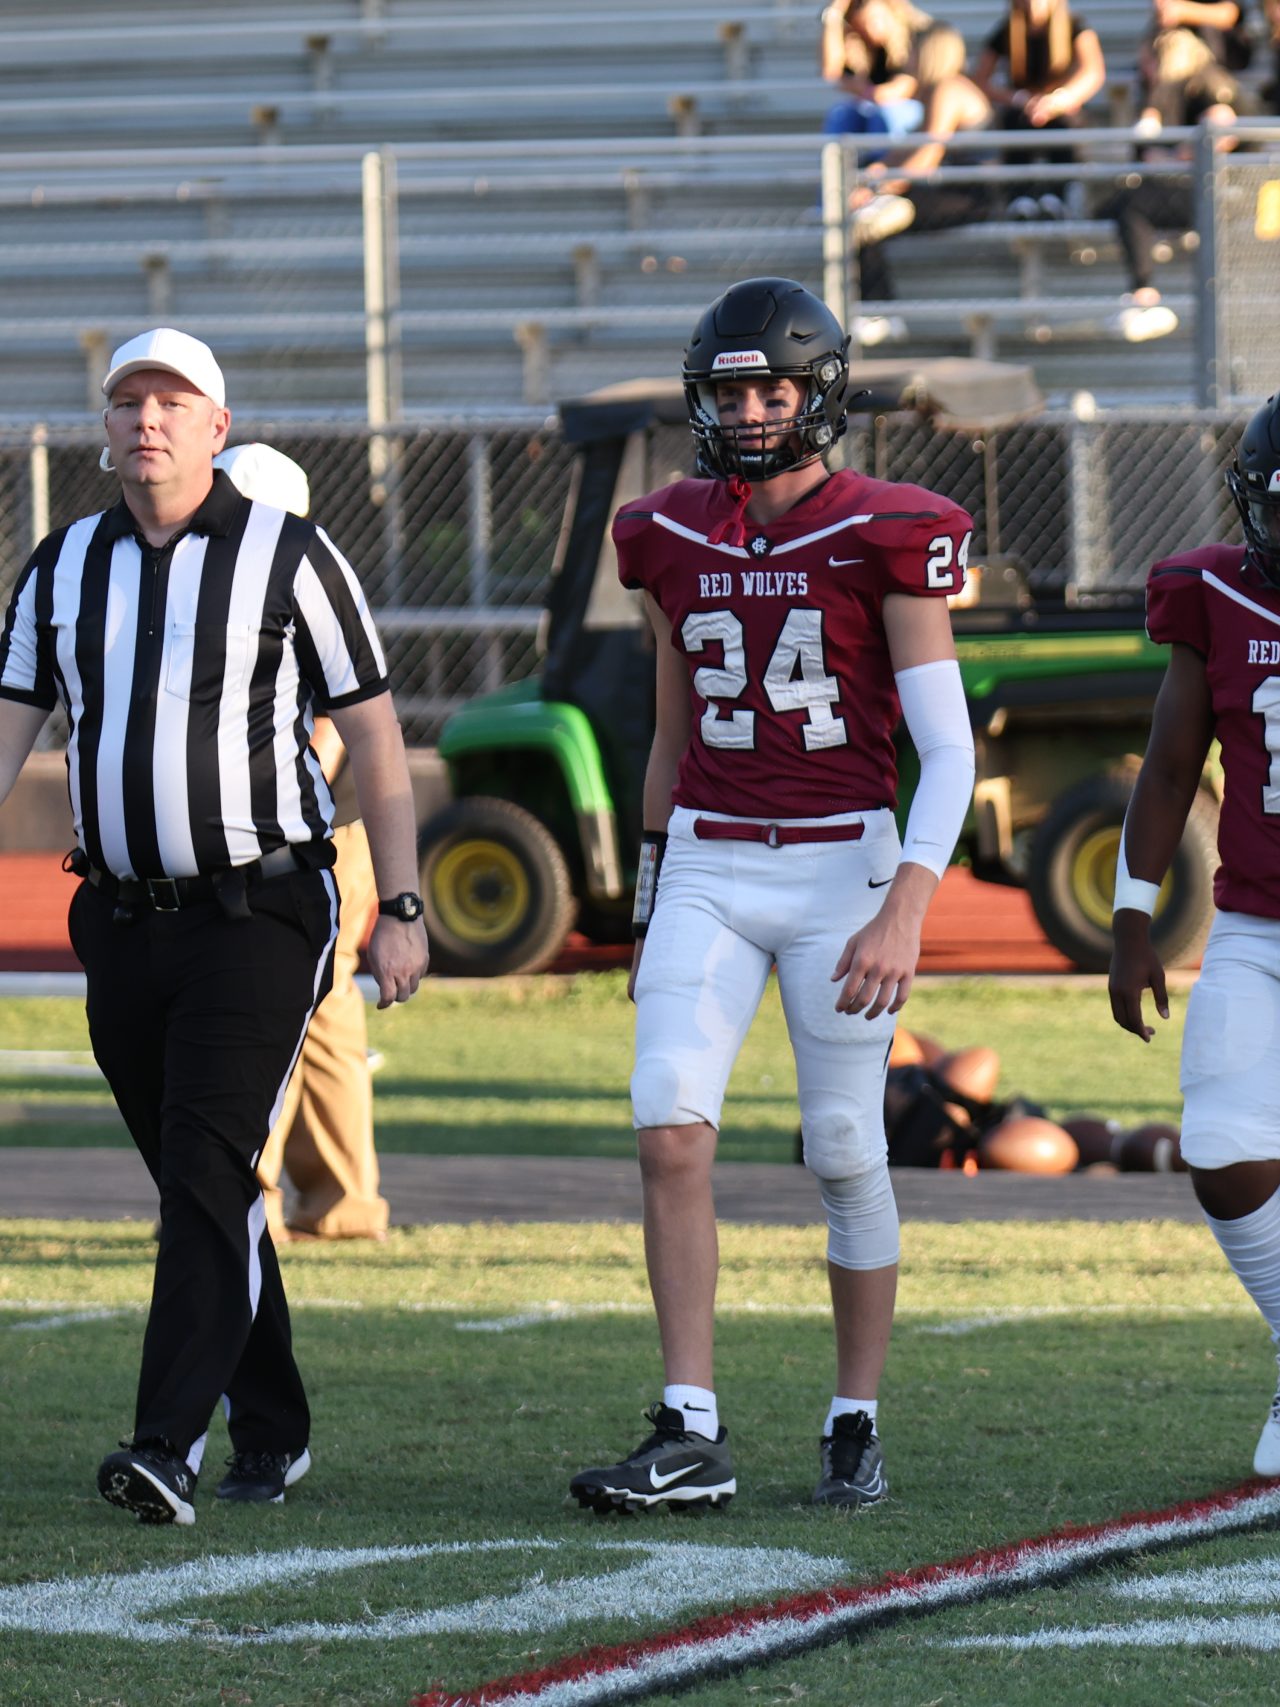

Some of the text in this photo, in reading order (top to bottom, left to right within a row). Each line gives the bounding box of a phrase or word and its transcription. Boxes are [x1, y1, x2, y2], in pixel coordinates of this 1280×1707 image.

[717, 353, 759, 365] Riddell
[699, 571, 808, 597] RED WOLVES
[1247, 639, 1280, 664] RED
[681, 608, 848, 751] 24
